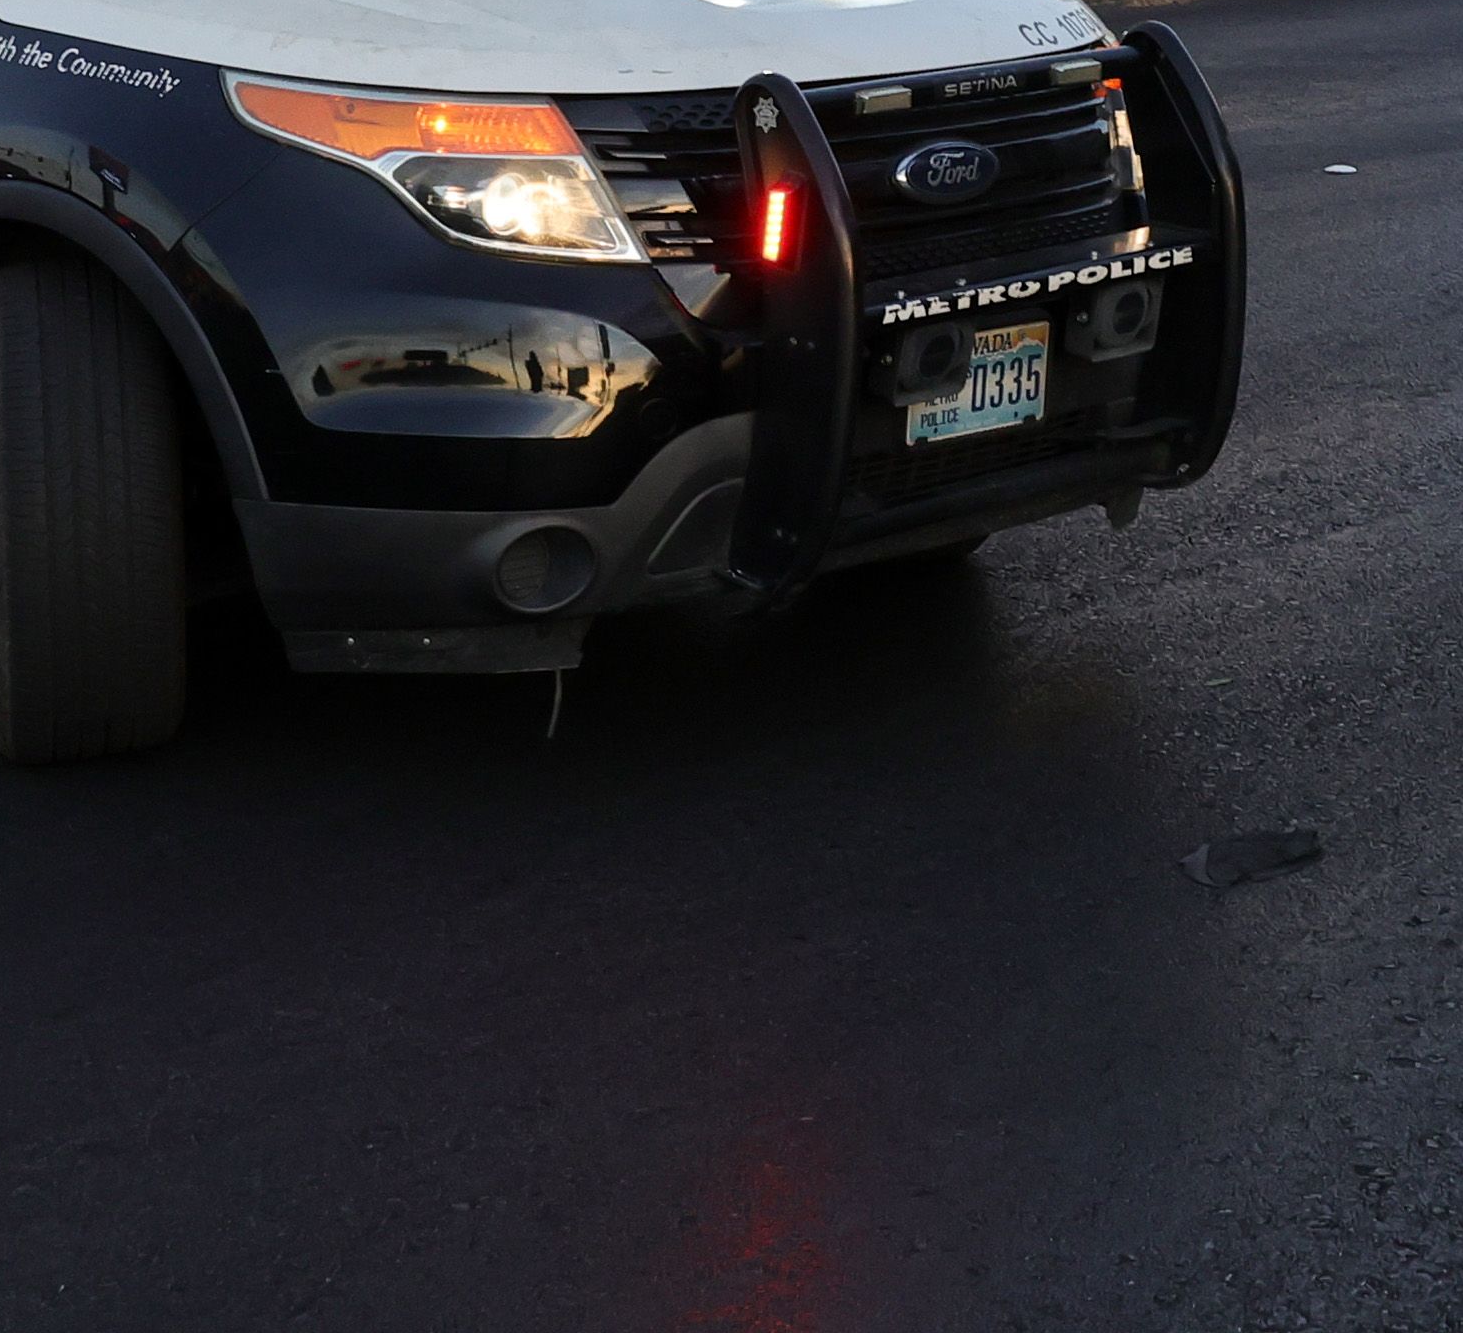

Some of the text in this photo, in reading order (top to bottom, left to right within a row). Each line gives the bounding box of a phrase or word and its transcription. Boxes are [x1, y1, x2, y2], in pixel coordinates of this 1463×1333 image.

[1018, 23, 1059, 47] CC
[18, 40, 52, 69] the
[57, 47, 180, 98] Community
[944, 75, 1018, 97] SETINA
[927, 151, 980, 187] Ford
[1048, 246, 1193, 292] POLICE
[973, 334, 1013, 356] VADA
[920, 407, 960, 429] POLICE
